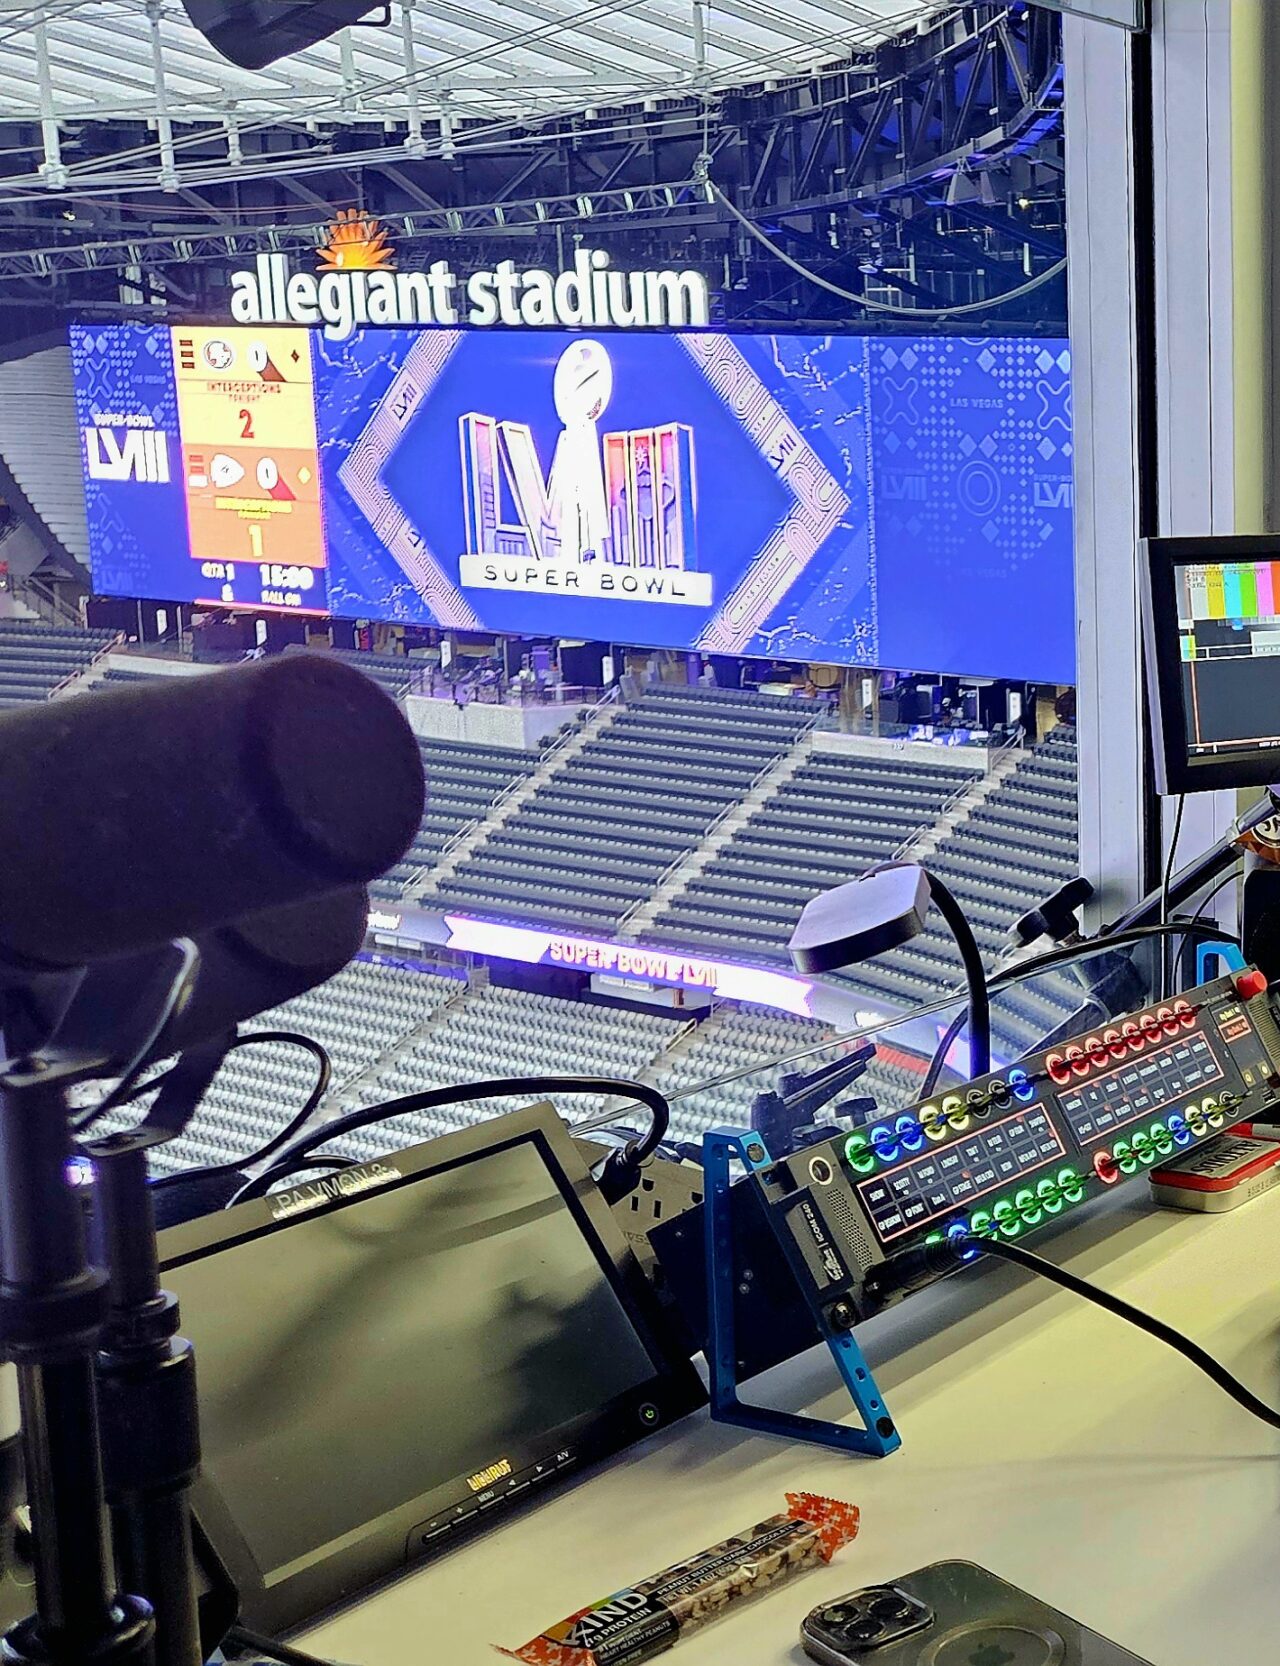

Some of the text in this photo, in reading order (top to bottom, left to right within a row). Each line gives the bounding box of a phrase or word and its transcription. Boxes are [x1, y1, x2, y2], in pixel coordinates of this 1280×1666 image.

[229, 248, 712, 342] allegiant stadium
[207, 382, 282, 394] INTERCEPTIONS
[950, 398, 1004, 409] LAS VEGAS
[238, 408, 255, 439] 2
[84, 427, 171, 484] LVIII
[248, 524, 263, 557] 1
[225, 562, 235, 581] 1
[484, 563, 686, 598] SUPER BOWL
[550, 942, 613, 970] SUPER
[617, 951, 678, 981] BOWL
[276, 1190, 304, 1211] PA
[307, 1167, 369, 1198] VMON
[809, 1219, 825, 1242] ICOM
[656, 1525, 796, 1595] PEANUT BUTTER DARK CHOCOLATE
[561, 1592, 648, 1645] KIND
[601, 1607, 652, 1637] PROTEIN
